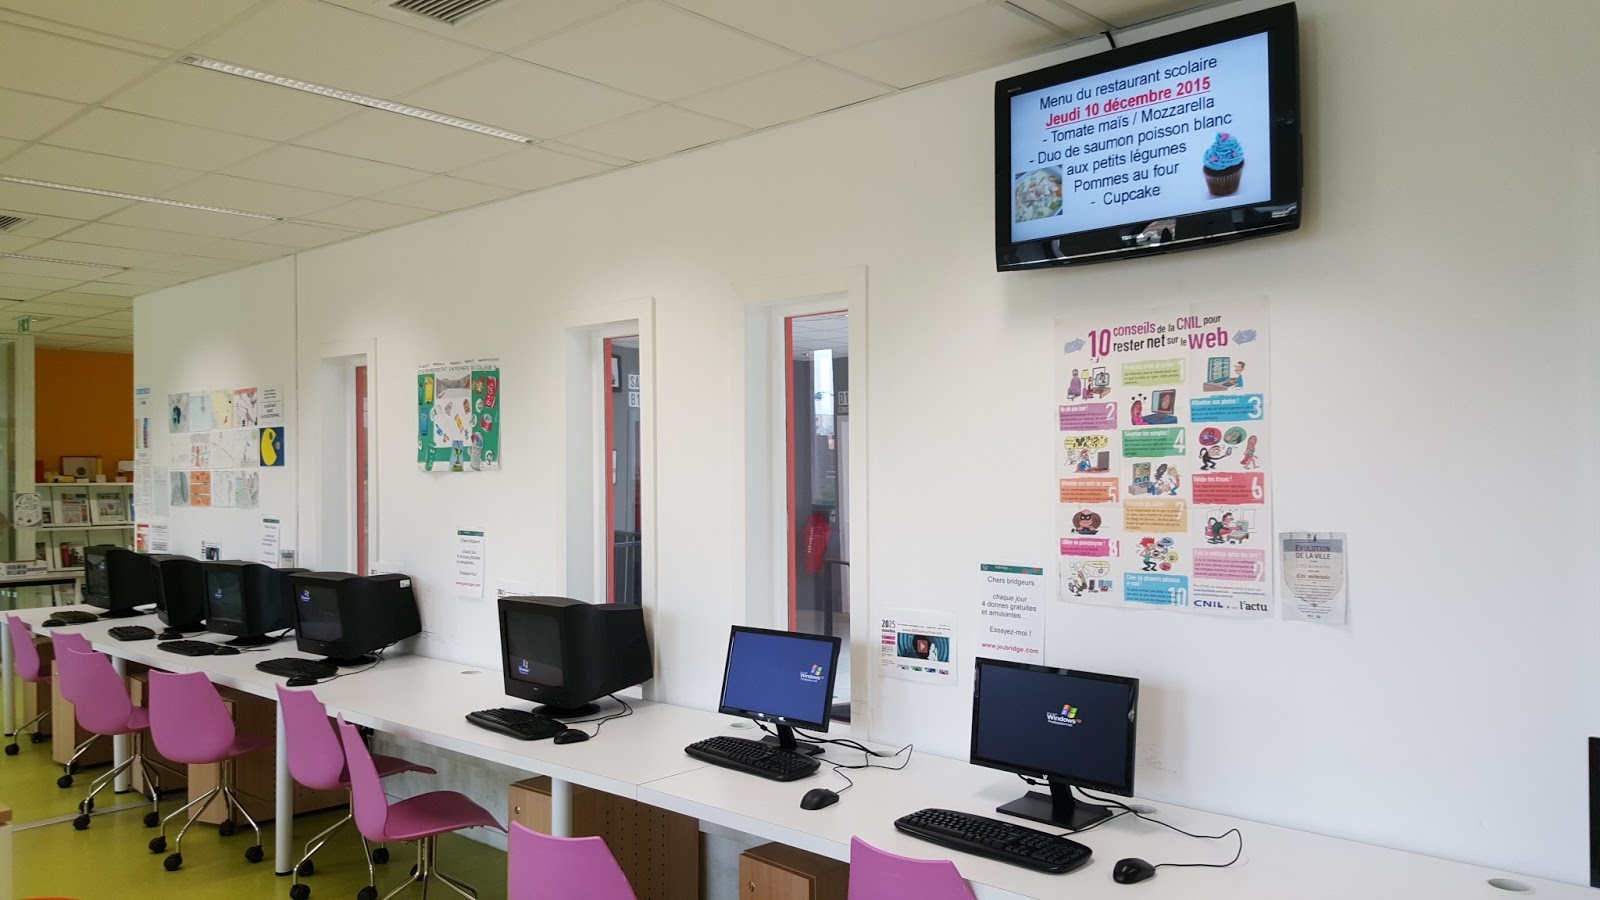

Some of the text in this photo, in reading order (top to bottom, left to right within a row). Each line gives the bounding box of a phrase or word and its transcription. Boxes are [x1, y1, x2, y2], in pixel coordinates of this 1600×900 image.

[1040, 57, 1217, 110] Menu du restaurant scolaire
[1046, 76, 1211, 127] Jeudi 10 décembre 2015
[1051, 124, 1094, 143] Tomate
[1098, 116, 1129, 132] maïs
[1132, 112, 1137, 125] /
[1141, 97, 1214, 123] Mozzarella
[1038, 151, 1062, 164] Duo
[1065, 145, 1080, 158] de
[1084, 134, 1133, 154] saumon
[1138, 122, 1189, 146] poisson
[1194, 114, 1232, 131] blanc
[1067, 142, 1187, 176] aux petits légumes
[1075, 163, 1179, 193] Pommes au four
[1103, 185, 1161, 205] Cupcake
[1088, 315, 1221, 357] 10 conseils de la CNIL pour
[1113, 326, 1228, 352] rester net sur le web
[1105, 403, 1116, 421] 2
[1247, 396, 1262, 419] 3
[1173, 429, 1185, 453] 4
[1108, 487, 1117, 503] 5
[1252, 476, 1263, 499] 6
[987, 576, 1035, 587] Chers bridgeurs
[987, 600, 1009, 609] donnes
[1010, 604, 1037, 612] gratuites
[992, 594, 1028, 603] chaque jour
[1193, 599, 1268, 612] CNIL l'actu
[881, 619, 896, 629] 2025
[989, 626, 1028, 637] Essayez-moi
[981, 643, 1039, 654] www.jeubridge.com
[800, 673, 821, 681] Windows
[1046, 713, 1077, 724] Windows
